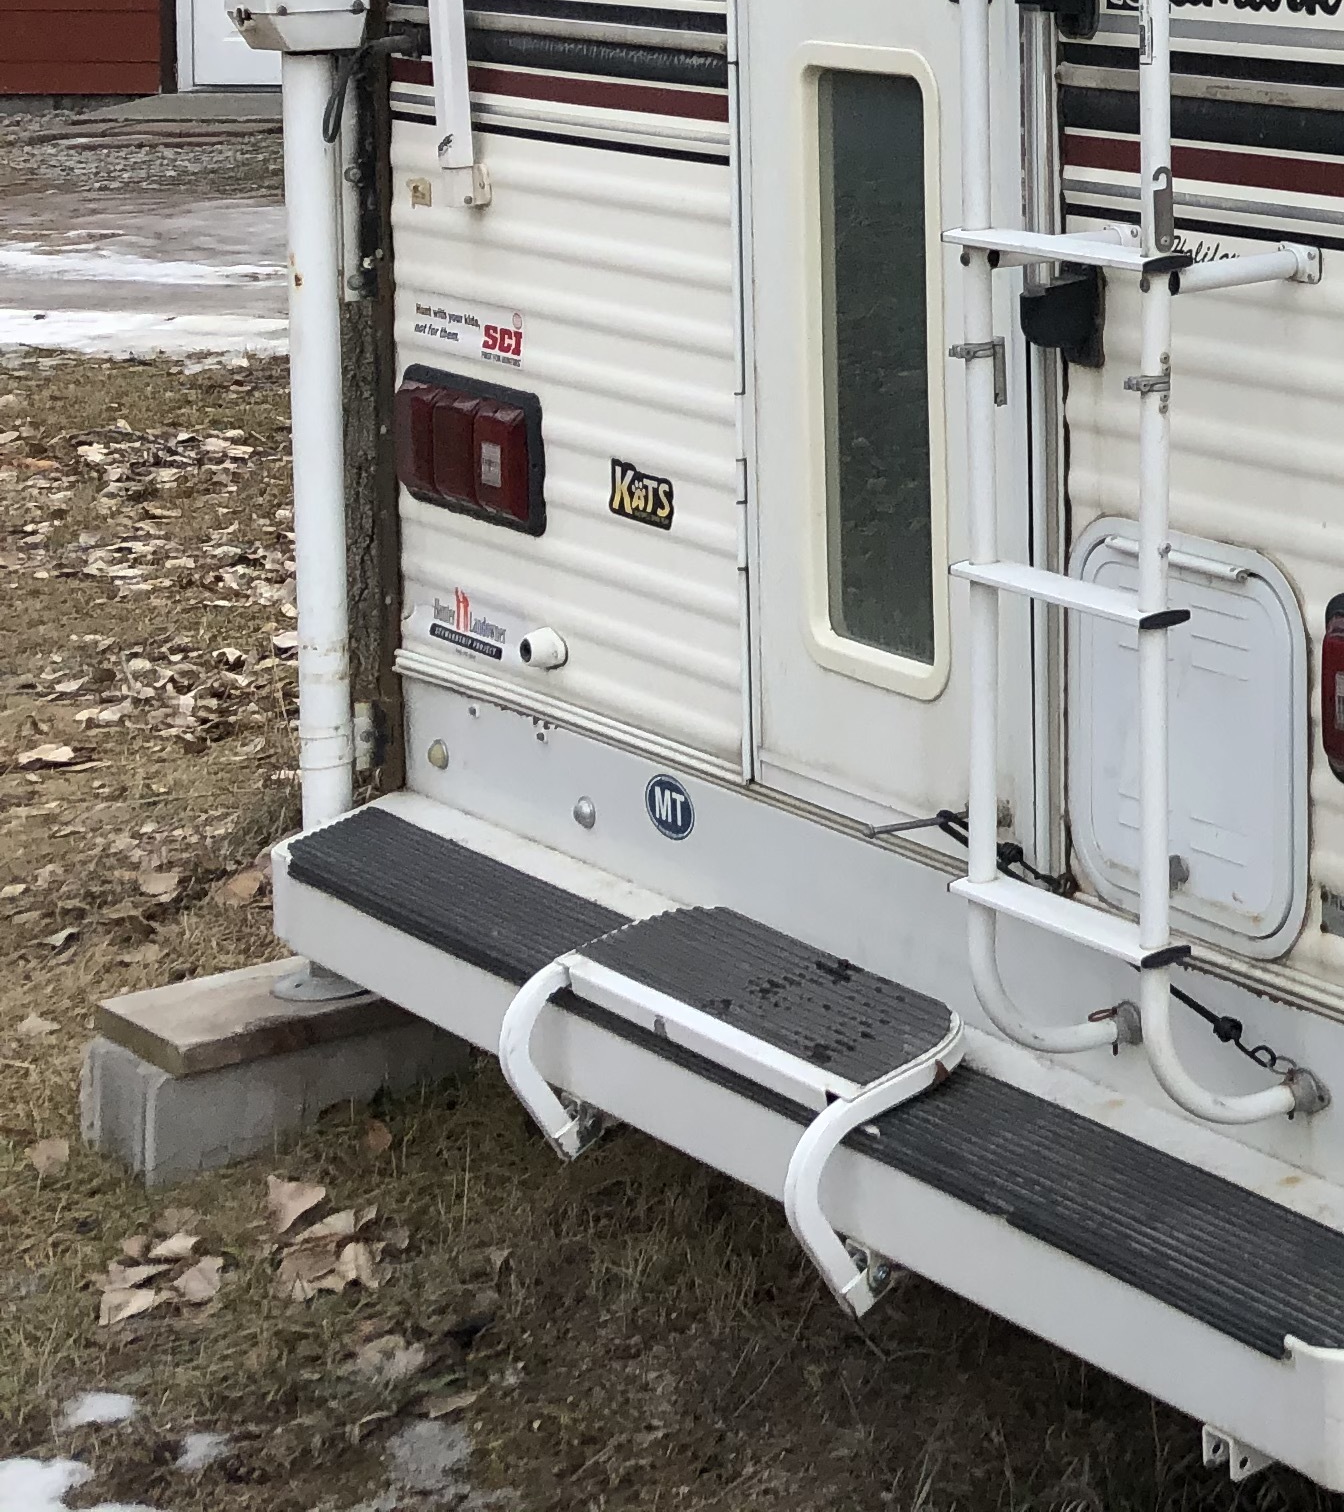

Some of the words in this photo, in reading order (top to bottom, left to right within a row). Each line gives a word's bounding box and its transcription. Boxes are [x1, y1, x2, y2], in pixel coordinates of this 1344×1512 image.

[415, 324, 428, 335] not
[428, 324, 439, 336] for
[482, 324, 523, 356] SCI
[654, 785, 685, 827] MT
